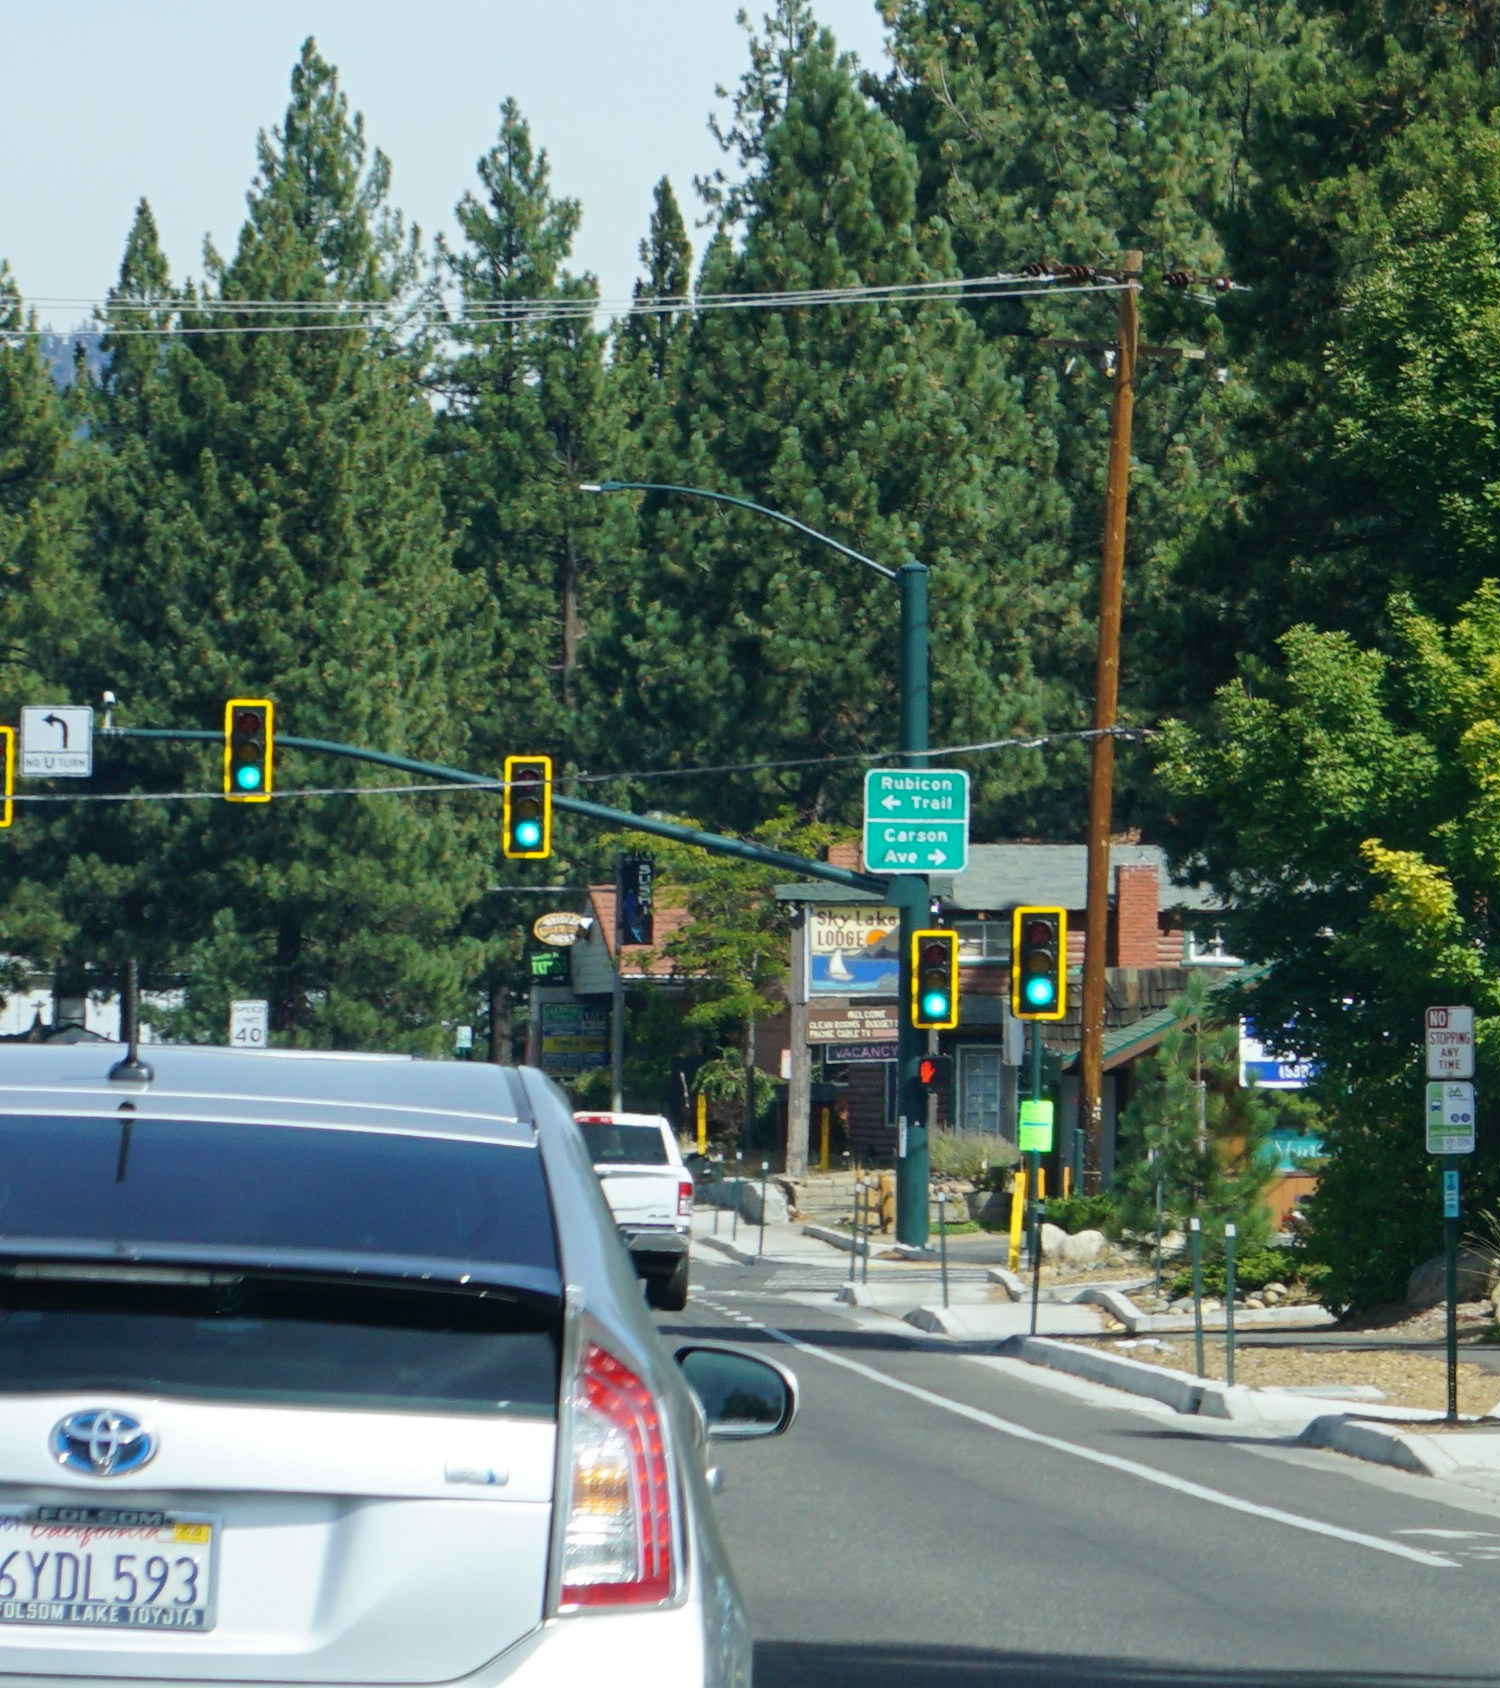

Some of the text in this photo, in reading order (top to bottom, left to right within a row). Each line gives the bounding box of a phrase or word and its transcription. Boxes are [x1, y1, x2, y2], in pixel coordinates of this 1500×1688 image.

[881, 776, 952, 791] Rubicon
[911, 795, 952, 810] Trail
[884, 828, 948, 843] Carson
[884, 849, 918, 864] Ave
[818, 910, 897, 928] Sky Lake
[818, 930, 865, 947] LODGE
[1429, 1010, 1447, 1027] NO
[235, 1027, 262, 1042] 40
[861, 1029, 871, 1037] TV
[1429, 1032, 1471, 1046] STOPPING
[836, 1045, 899, 1058] VACANCY
[1441, 1047, 1459, 1057] ANY
[1438, 1059, 1461, 1070] TIME
[0, 1550, 199, 1606] 6YDL593
[0, 1602, 64, 1621] OLSOM
[72, 1606, 119, 1623] LAKE
